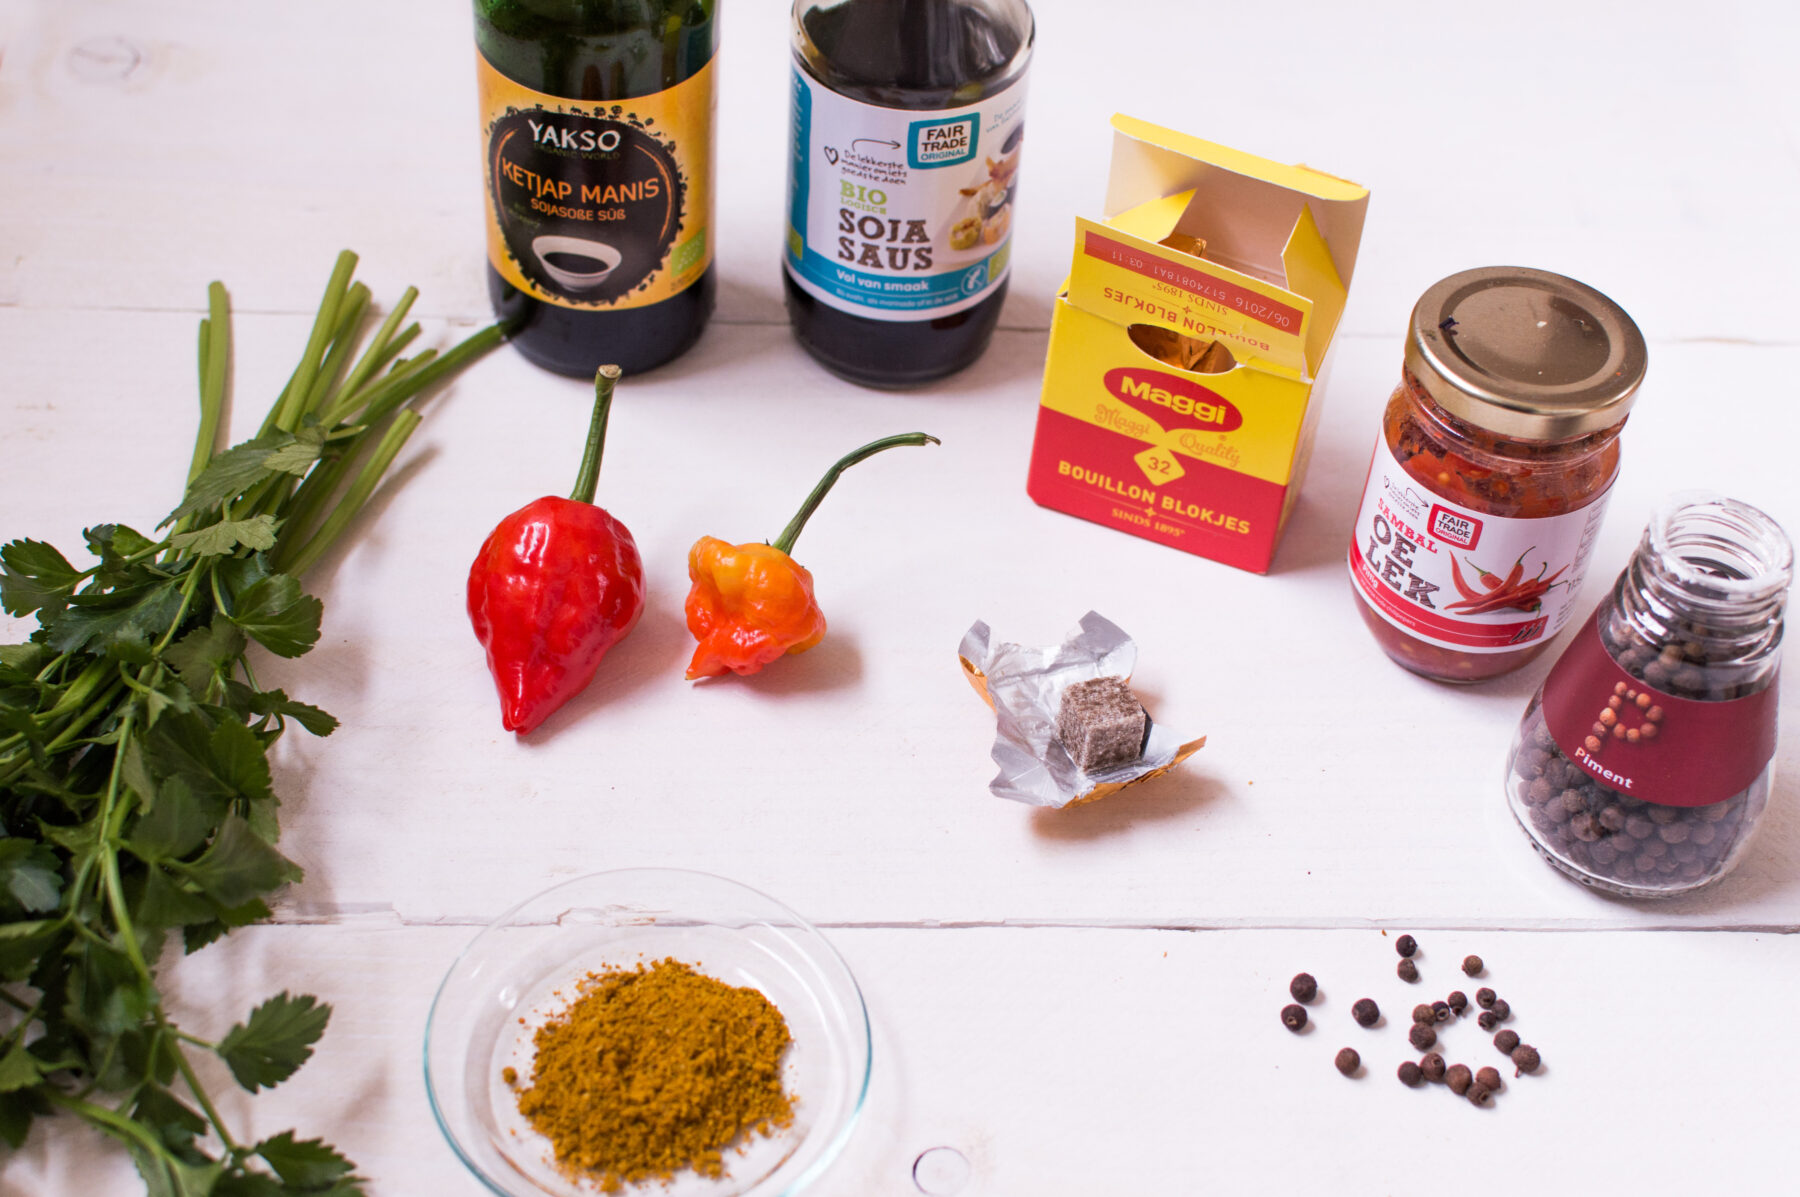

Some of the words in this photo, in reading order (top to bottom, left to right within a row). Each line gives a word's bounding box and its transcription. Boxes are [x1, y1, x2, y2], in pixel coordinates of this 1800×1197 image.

[528, 118, 621, 152] YAKSO
[921, 136, 968, 153] TRADE
[926, 124, 965, 141] FAIR
[920, 148, 967, 162] ORIGINAL
[502, 156, 573, 200] KETJAP
[581, 177, 660, 204] MANIS
[840, 178, 888, 206] BIO
[840, 197, 887, 215] LOGISCH
[838, 207, 931, 244] SOJA
[838, 236, 933, 271] SAUS
[836, 268, 856, 284] Vol
[857, 277, 882, 290] van
[883, 280, 930, 292] smaak
[1104, 287, 1177, 323] BLOKJES
[1188, 293, 1228, 316] SINDS
[1235, 296, 1290, 328] 06/2016
[1119, 376, 1227, 425] Maggi
[1094, 403, 1150, 437] Maggi
[1179, 432, 1241, 468] Quality
[1147, 456, 1171, 475] 32
[1058, 460, 1156, 505] BOUILLON
[1161, 495, 1251, 535] BLOKJES
[1112, 507, 1151, 527] SINDS
[1378, 497, 1438, 554] SAMBAL
[1437, 520, 1471, 539] TRADE
[1441, 512, 1470, 531] FAIR
[1373, 513, 1417, 569] OE
[1435, 527, 1468, 545] ORIGINAL
[1365, 535, 1440, 610] LEK
[1574, 746, 1634, 789] Piment
